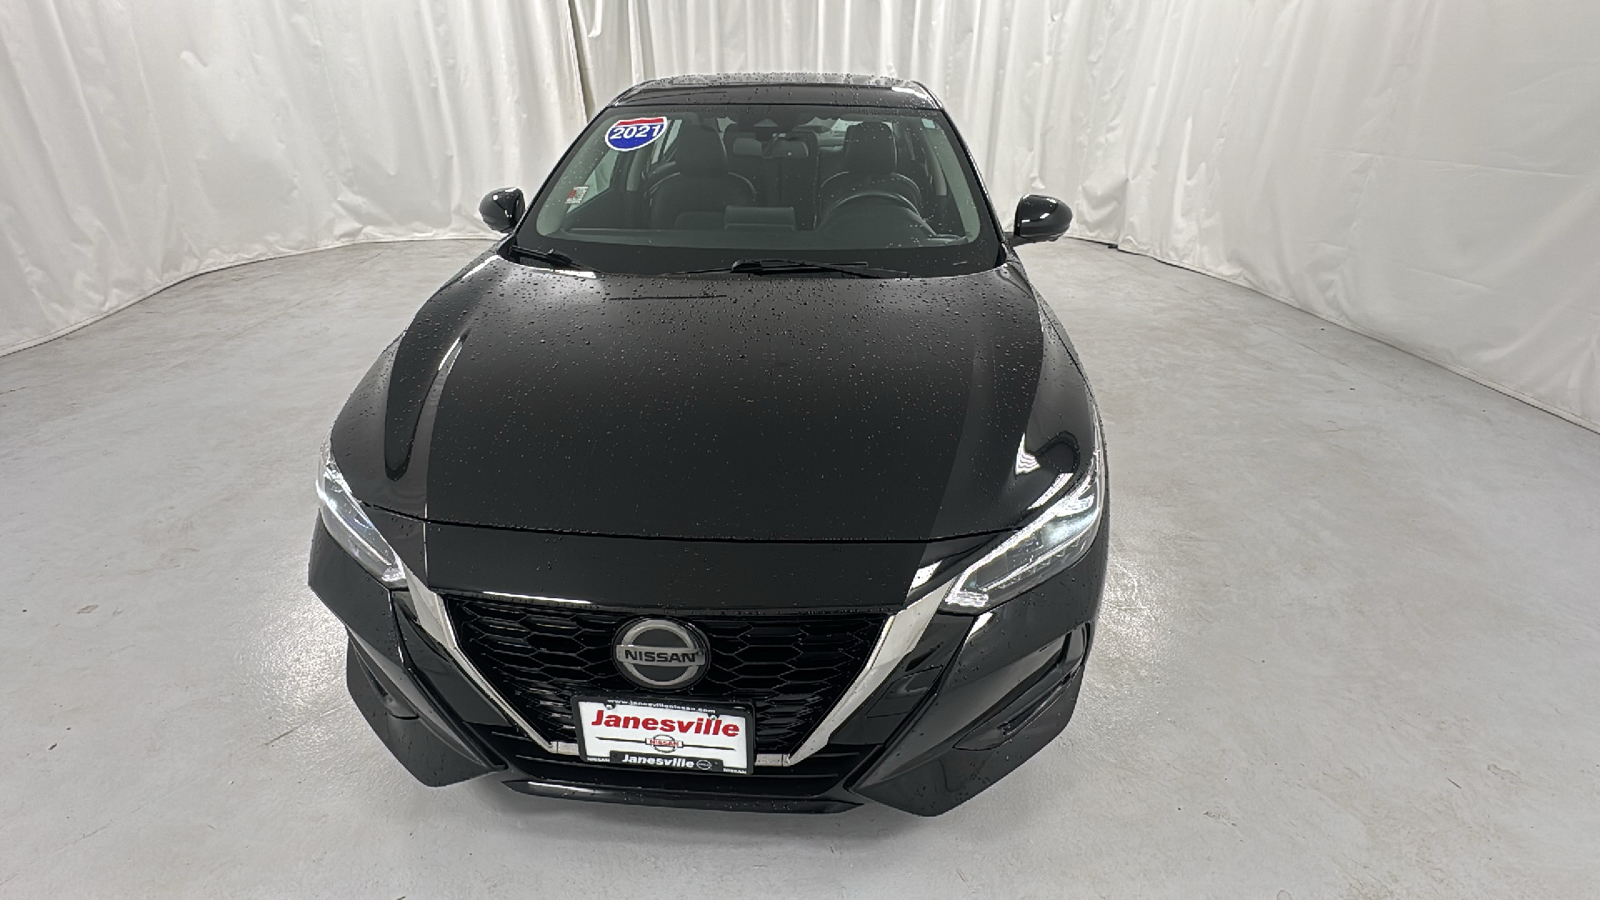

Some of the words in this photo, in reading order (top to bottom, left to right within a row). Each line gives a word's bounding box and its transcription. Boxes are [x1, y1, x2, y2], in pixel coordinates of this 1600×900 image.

[609, 124, 661, 140] 2021
[624, 649, 697, 663] NISSAN
[591, 709, 740, 738] Janesville
[649, 739, 679, 747] NISSAN
[621, 754, 695, 769] Janesville
